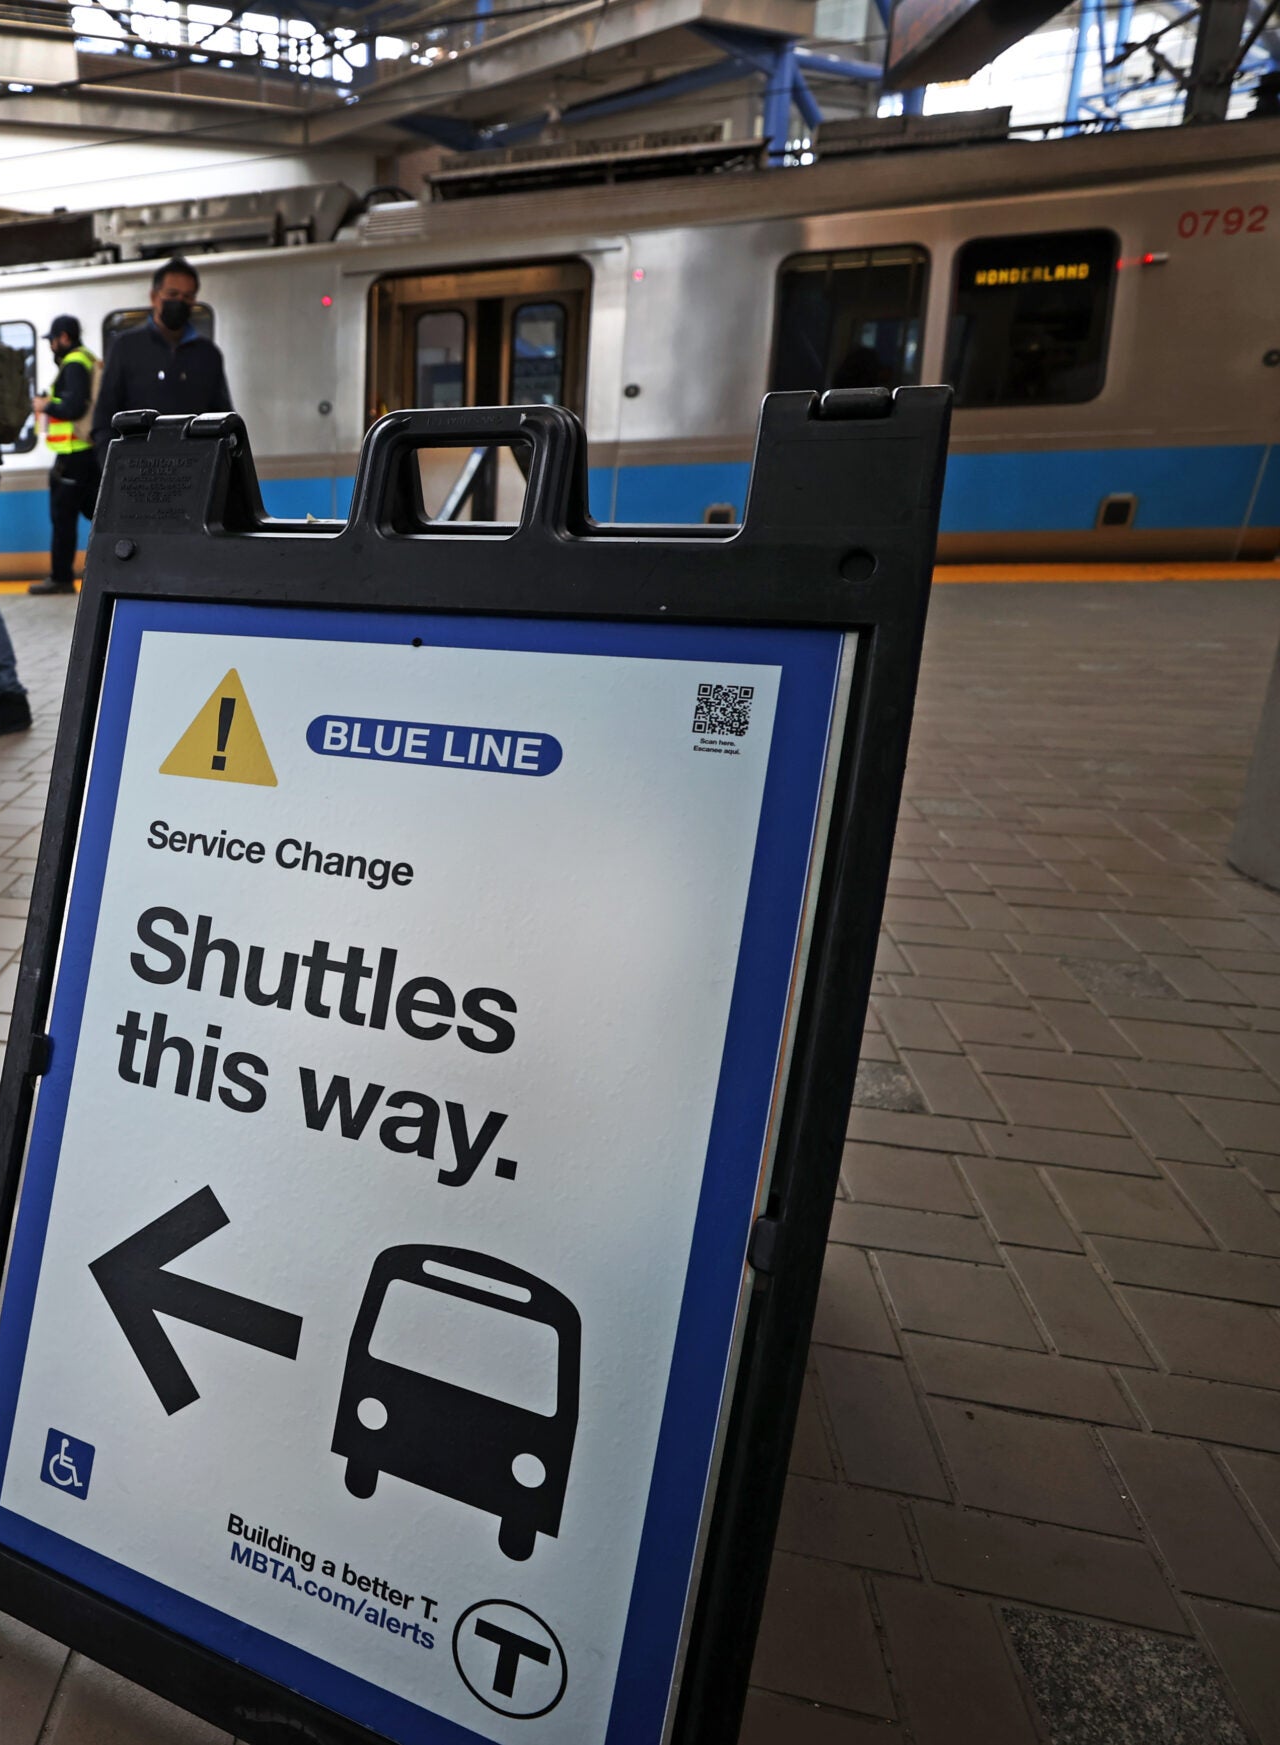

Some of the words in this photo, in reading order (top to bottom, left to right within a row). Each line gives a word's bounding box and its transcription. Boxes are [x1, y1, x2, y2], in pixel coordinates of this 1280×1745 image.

[1178, 205, 1269, 239] 0792
[975, 263, 1089, 285] WONDERLAND
[322, 720, 431, 760] BLUE
[442, 730, 542, 771] LINE
[147, 820, 266, 864] Service
[275, 838, 414, 890] Change
[130, 906, 518, 1055] Shuttles
[116, 1010, 269, 1114] this
[299, 1067, 518, 1187] way.
[227, 1513, 317, 1572] Building
[321, 1559, 336, 1578] a
[342, 1563, 415, 1611] better
[421, 1596, 439, 1623] T.
[230, 1541, 435, 1650] MBTA.com/alerts
[474, 1618, 551, 1698] T
